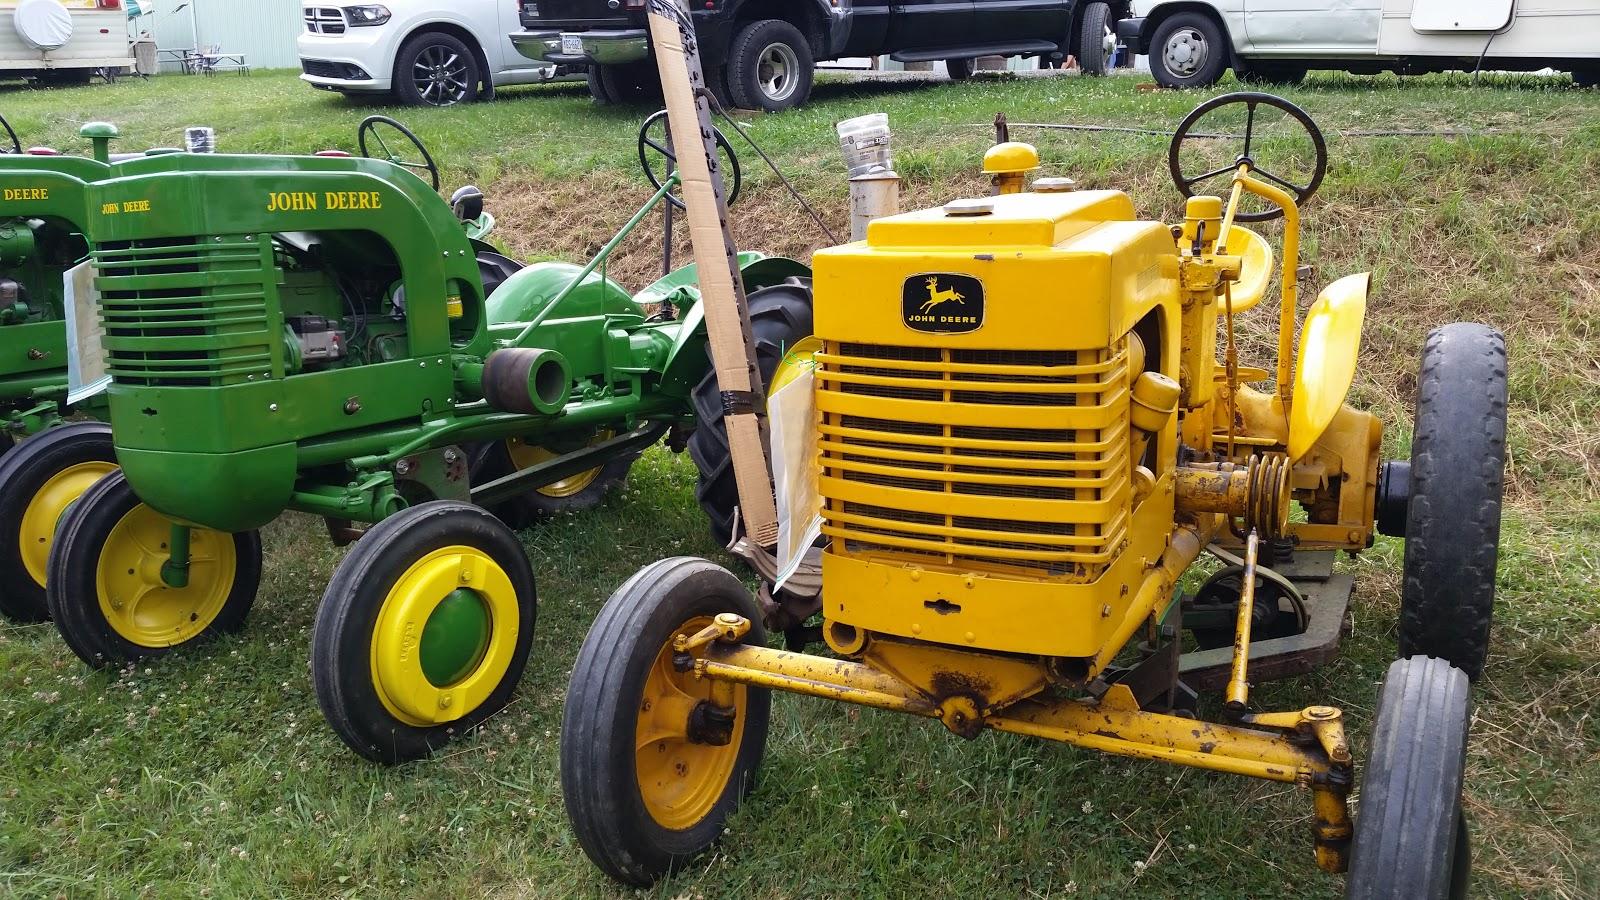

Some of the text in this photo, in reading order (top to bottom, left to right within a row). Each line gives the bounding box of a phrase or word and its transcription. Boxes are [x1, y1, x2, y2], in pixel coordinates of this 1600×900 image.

[4, 188, 49, 201] DEERE
[267, 191, 382, 211] JOHN DEERE
[102, 199, 151, 215] JOHN DEERE
[908, 314, 977, 324] JOHN DEERE
